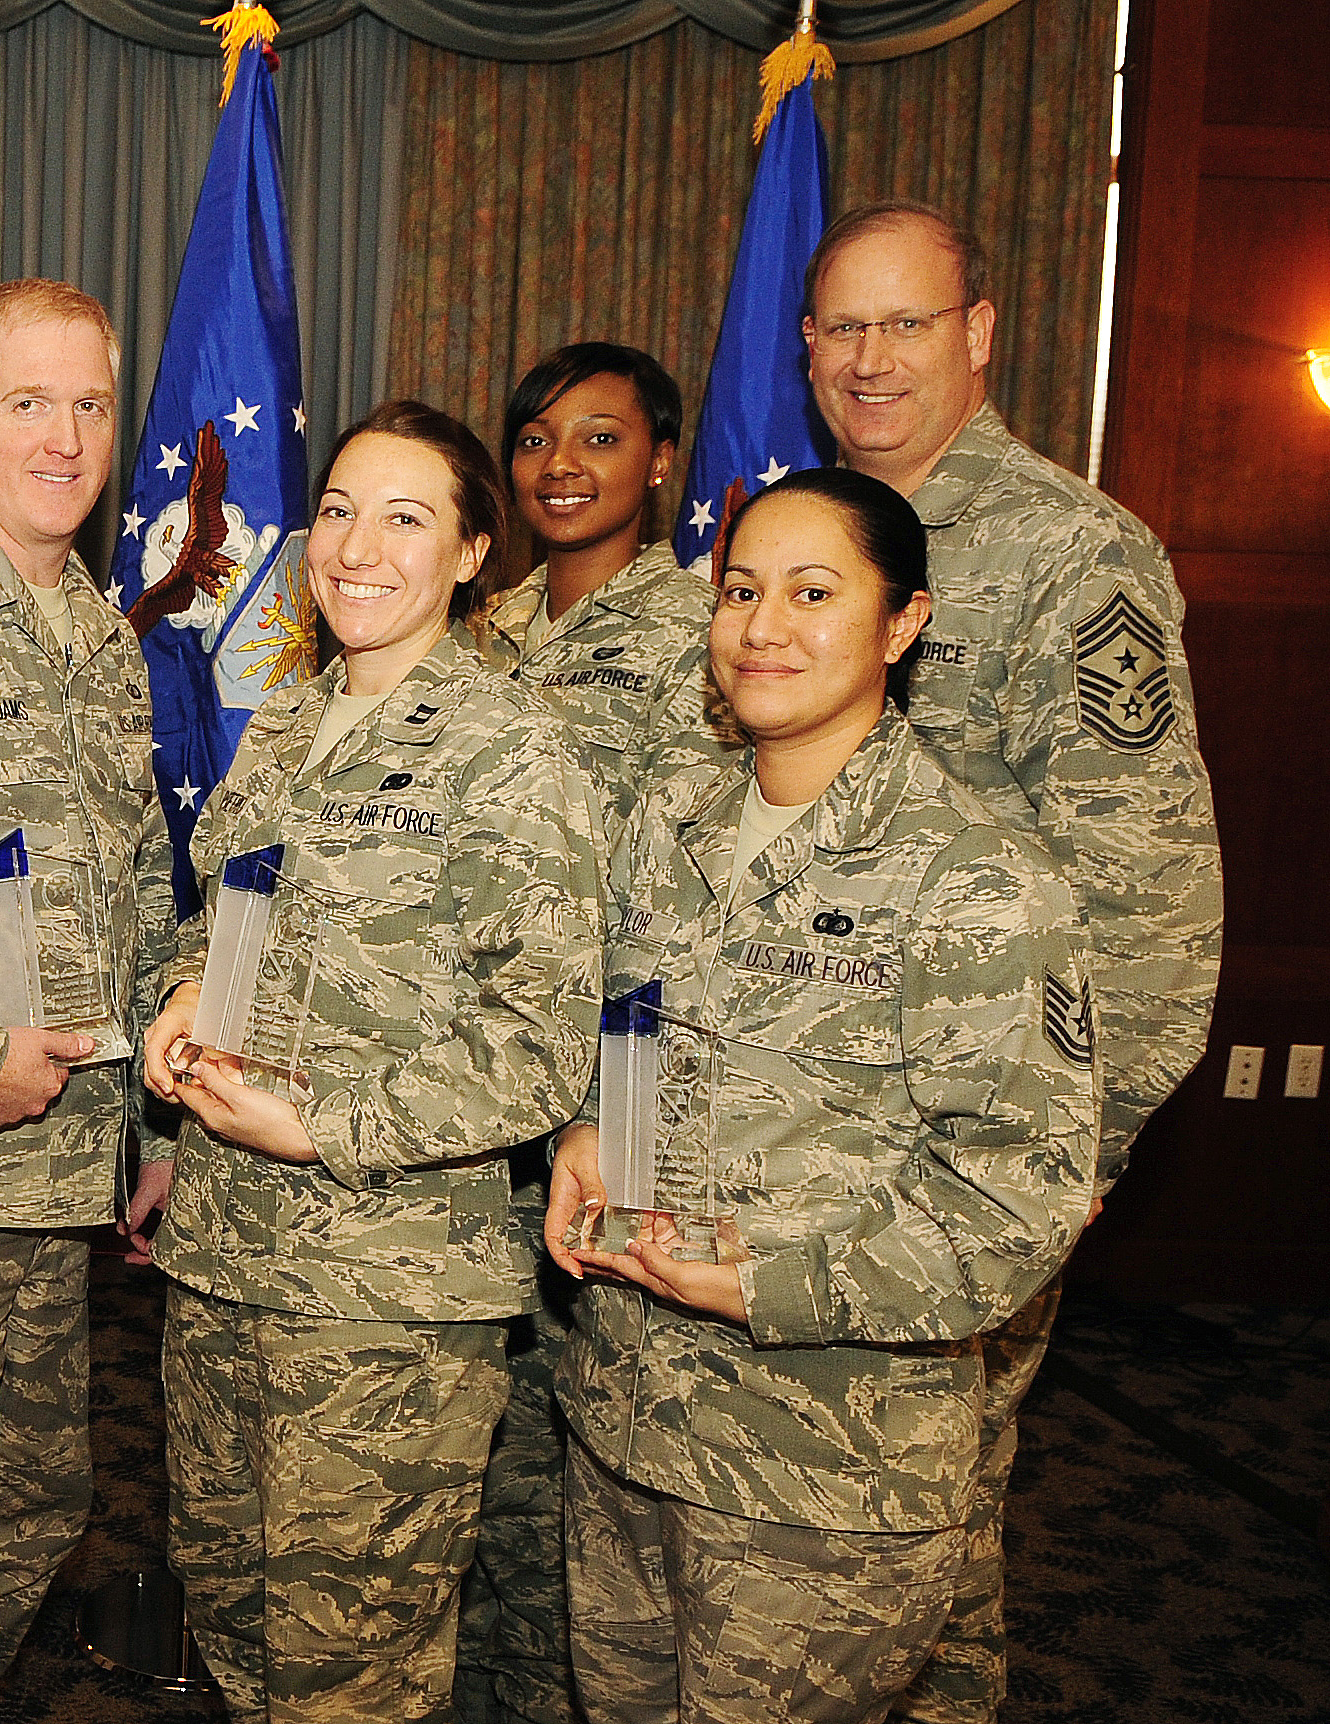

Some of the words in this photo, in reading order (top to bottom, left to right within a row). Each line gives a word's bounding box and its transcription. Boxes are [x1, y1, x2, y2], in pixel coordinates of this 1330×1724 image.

[920, 640, 968, 664] ORCE
[564, 670, 592, 687] AIR
[591, 668, 647, 692] FORCE
[319, 801, 348, 824] U.S.
[350, 804, 379, 827] AIR
[381, 804, 442, 837] FORCE
[745, 944, 776, 971] U.S.
[781, 949, 816, 978] AIR
[821, 955, 893, 989] FORCE
